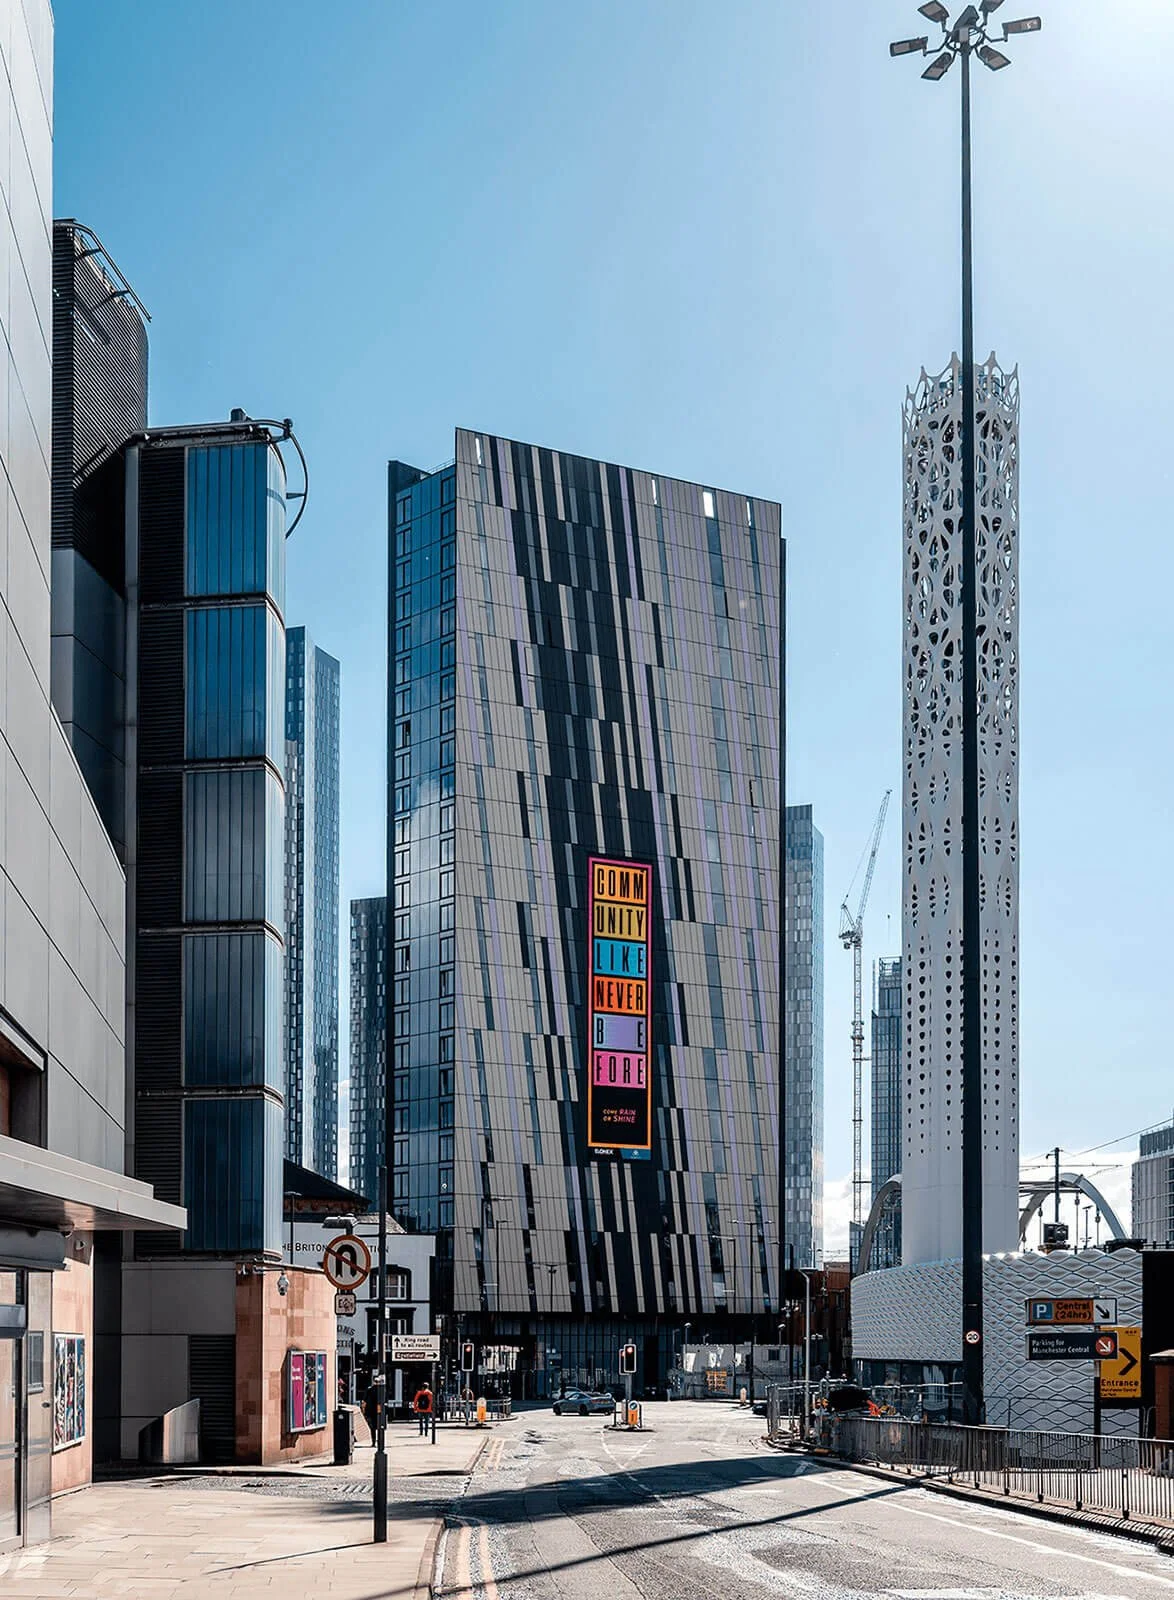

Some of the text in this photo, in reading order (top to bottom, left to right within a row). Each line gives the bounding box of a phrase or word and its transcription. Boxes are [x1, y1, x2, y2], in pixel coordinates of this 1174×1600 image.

[597, 868, 644, 900] COMM
[596, 905, 644, 937] UNITY
[596, 942, 644, 974] LIKE
[596, 980, 644, 1011] NEVER
[596, 1055, 644, 1085] FORE
[619, 1108, 637, 1116] RAIN
[612, 1115, 636, 1124] SHINE
[295, 1242, 329, 1252] BRITON
[1036, 1301, 1090, 1319] P Central
[1055, 1310, 1092, 1321] (24hrs)
[967, 1333, 979, 1341] 20
[1032, 1339, 1055, 1348] Parking
[1101, 1378, 1139, 1387] Entrance
